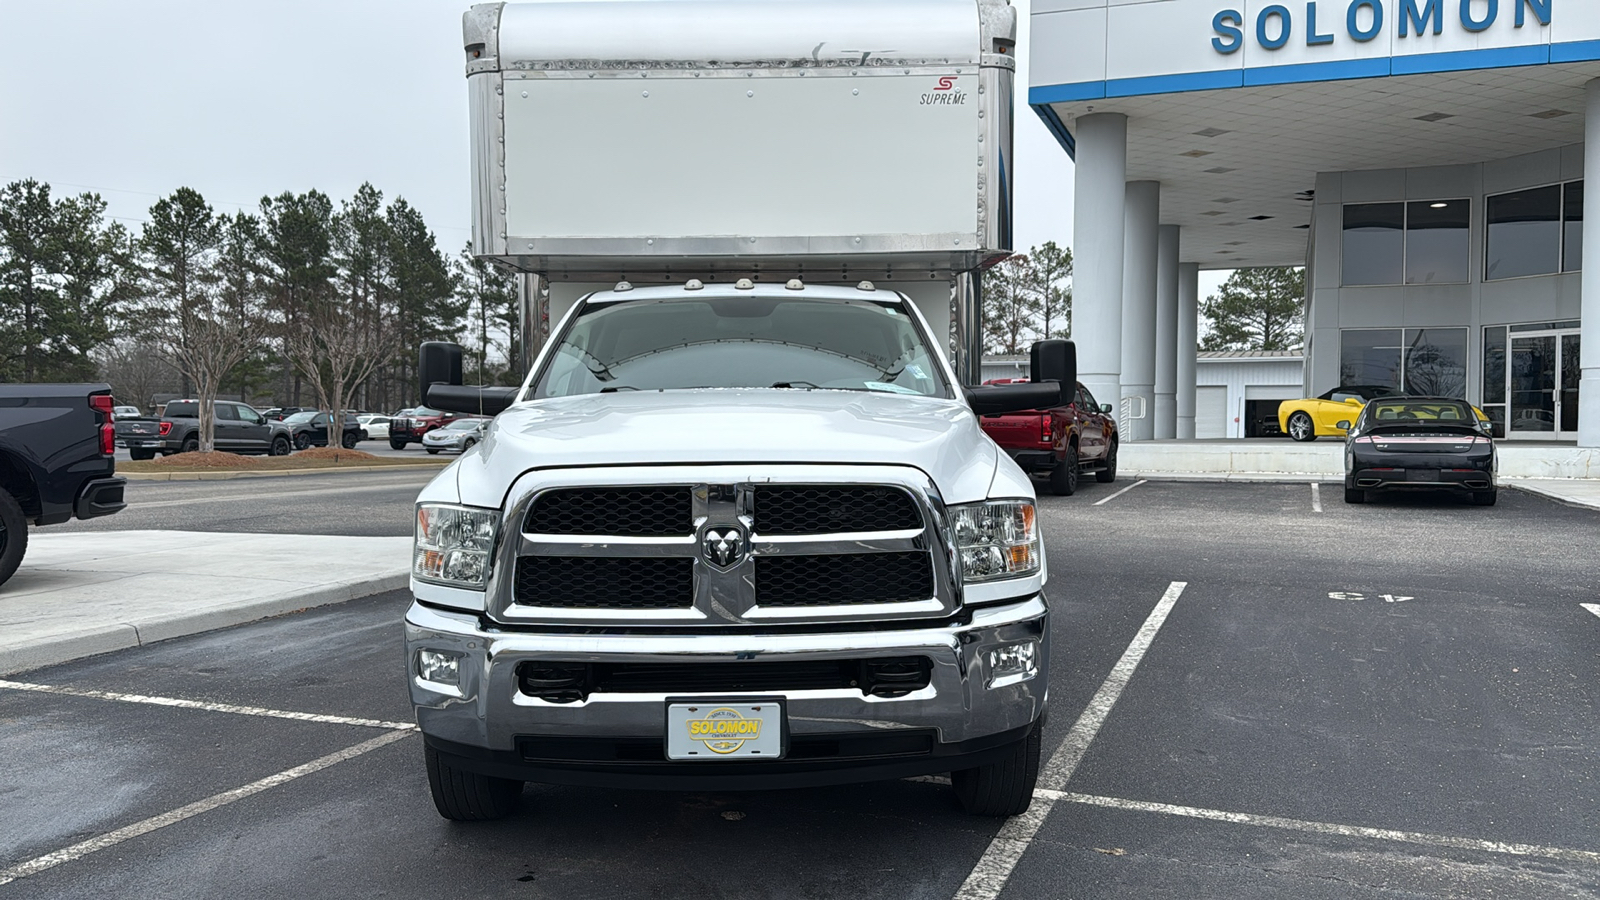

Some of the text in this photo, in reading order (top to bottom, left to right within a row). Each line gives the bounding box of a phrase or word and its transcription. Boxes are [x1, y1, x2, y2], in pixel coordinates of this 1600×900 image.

[1211, 0, 1552, 54] SOLOMON
[920, 93, 967, 105] SUPREME
[691, 721, 757, 734] SOLOMON
